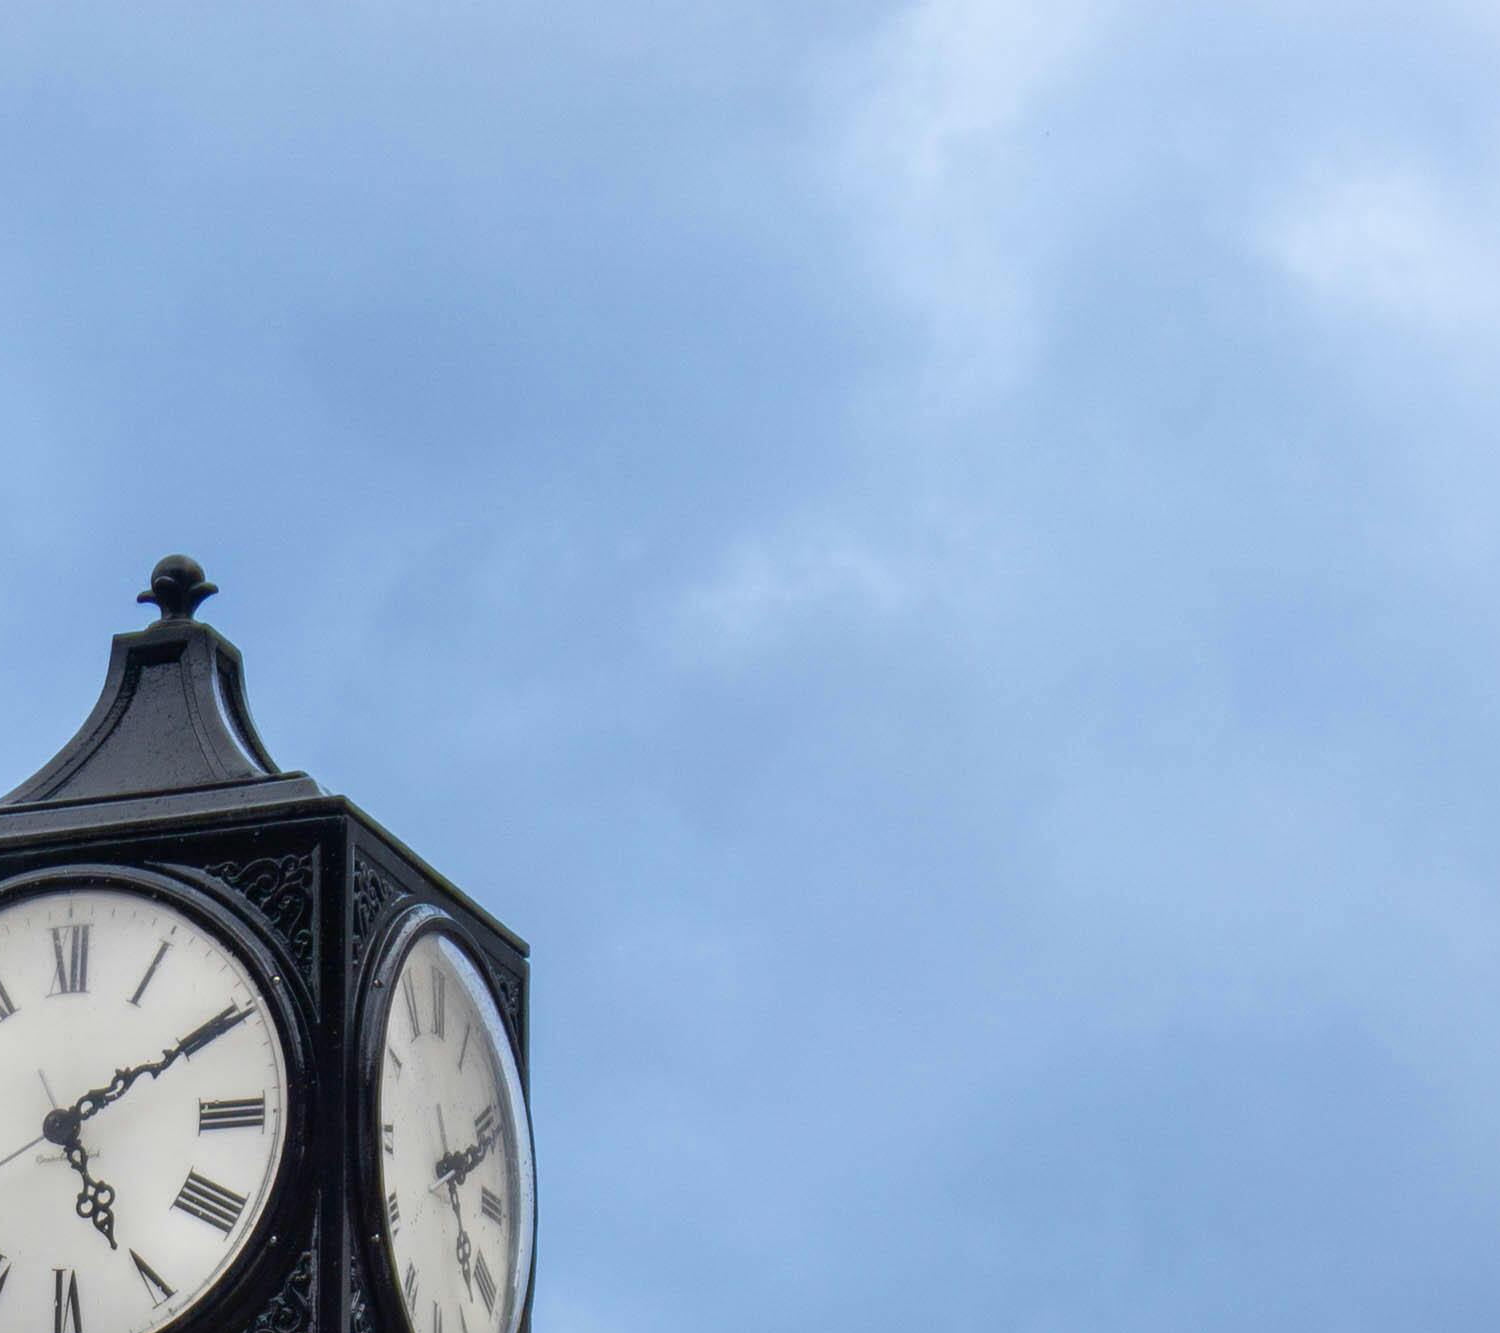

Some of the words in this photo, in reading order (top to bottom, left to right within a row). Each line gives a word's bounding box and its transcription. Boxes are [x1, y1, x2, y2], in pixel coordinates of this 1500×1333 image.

[46, 924, 93, 998] XII
[126, 940, 173, 1007] I
[198, 1090, 265, 1136] III
[129, 1248, 179, 1309] V
